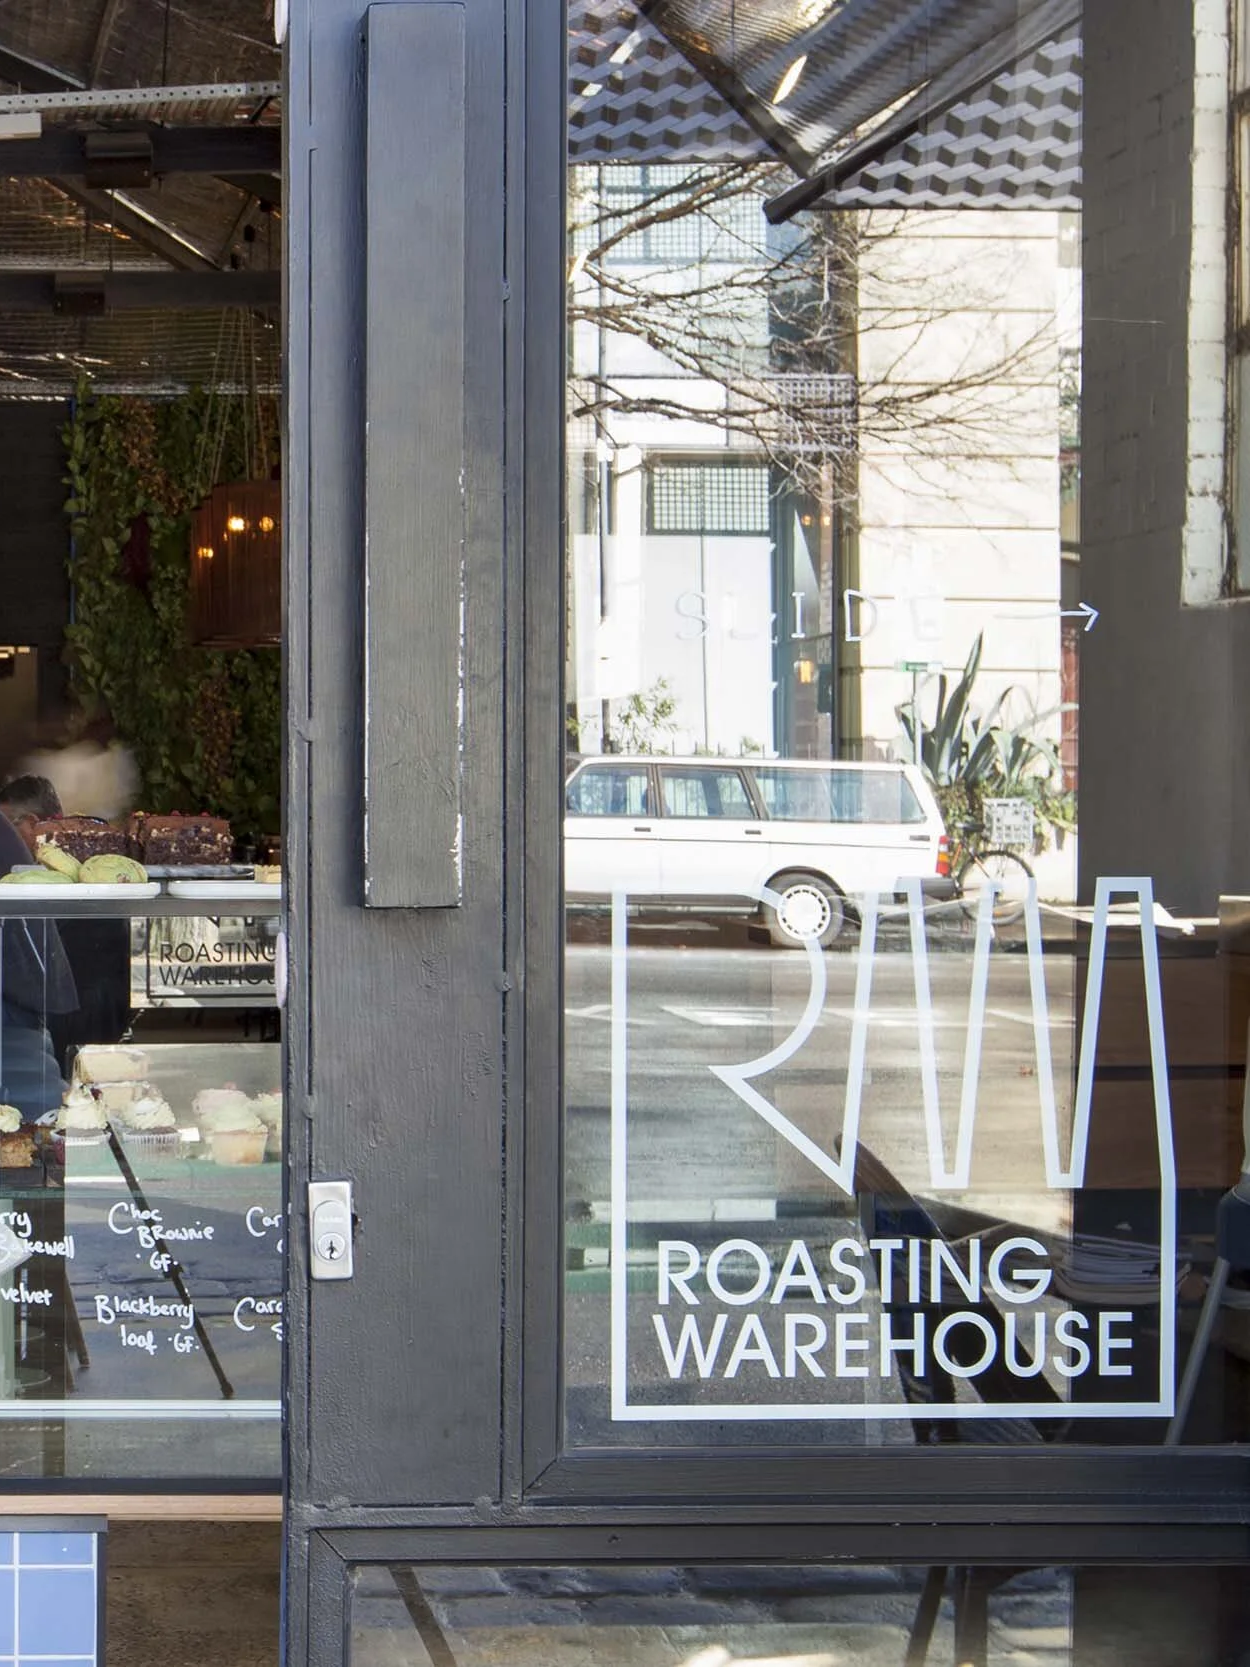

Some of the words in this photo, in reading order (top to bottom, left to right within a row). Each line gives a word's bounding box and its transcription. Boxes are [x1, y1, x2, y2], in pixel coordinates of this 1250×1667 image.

[108, 1202, 164, 1235] Choc
[657, 1237, 1053, 1306] ROASTING
[1, 1284, 53, 1307] velvet
[95, 1294, 195, 1330] Blackberry
[120, 1324, 158, 1356] loaf
[652, 1311, 1134, 1379] WAREHOUSE
